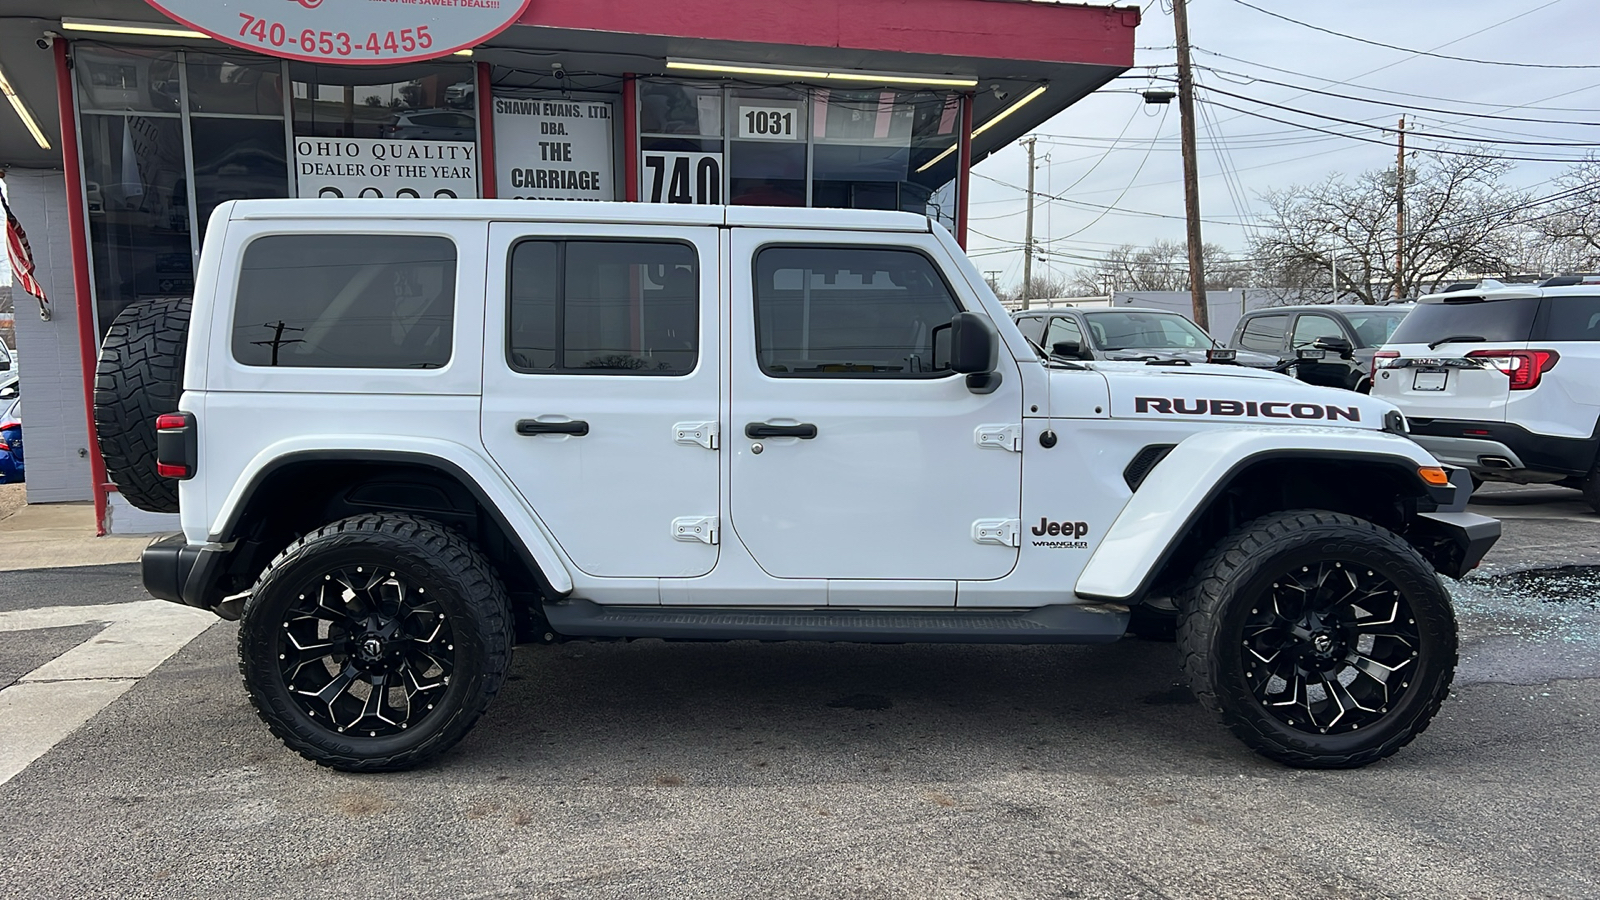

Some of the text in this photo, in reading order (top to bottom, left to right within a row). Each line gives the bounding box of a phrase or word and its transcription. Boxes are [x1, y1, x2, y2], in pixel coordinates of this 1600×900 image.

[239, 12, 433, 56] 740-653-4455
[496, 100, 541, 116] SHAWN
[588, 105, 611, 119] LTD.
[540, 122, 569, 136] DBA.
[745, 110, 792, 135] 1031
[298, 141, 473, 161] OHIO QUALITY
[538, 141, 573, 162] THE
[301, 163, 472, 179] DEALER OF THE YEAR
[511, 168, 601, 191] CARRIAGE
[645, 155, 721, 205] 740
[1135, 396, 1361, 422] RUBICON
[1031, 517, 1089, 539] Jeep
